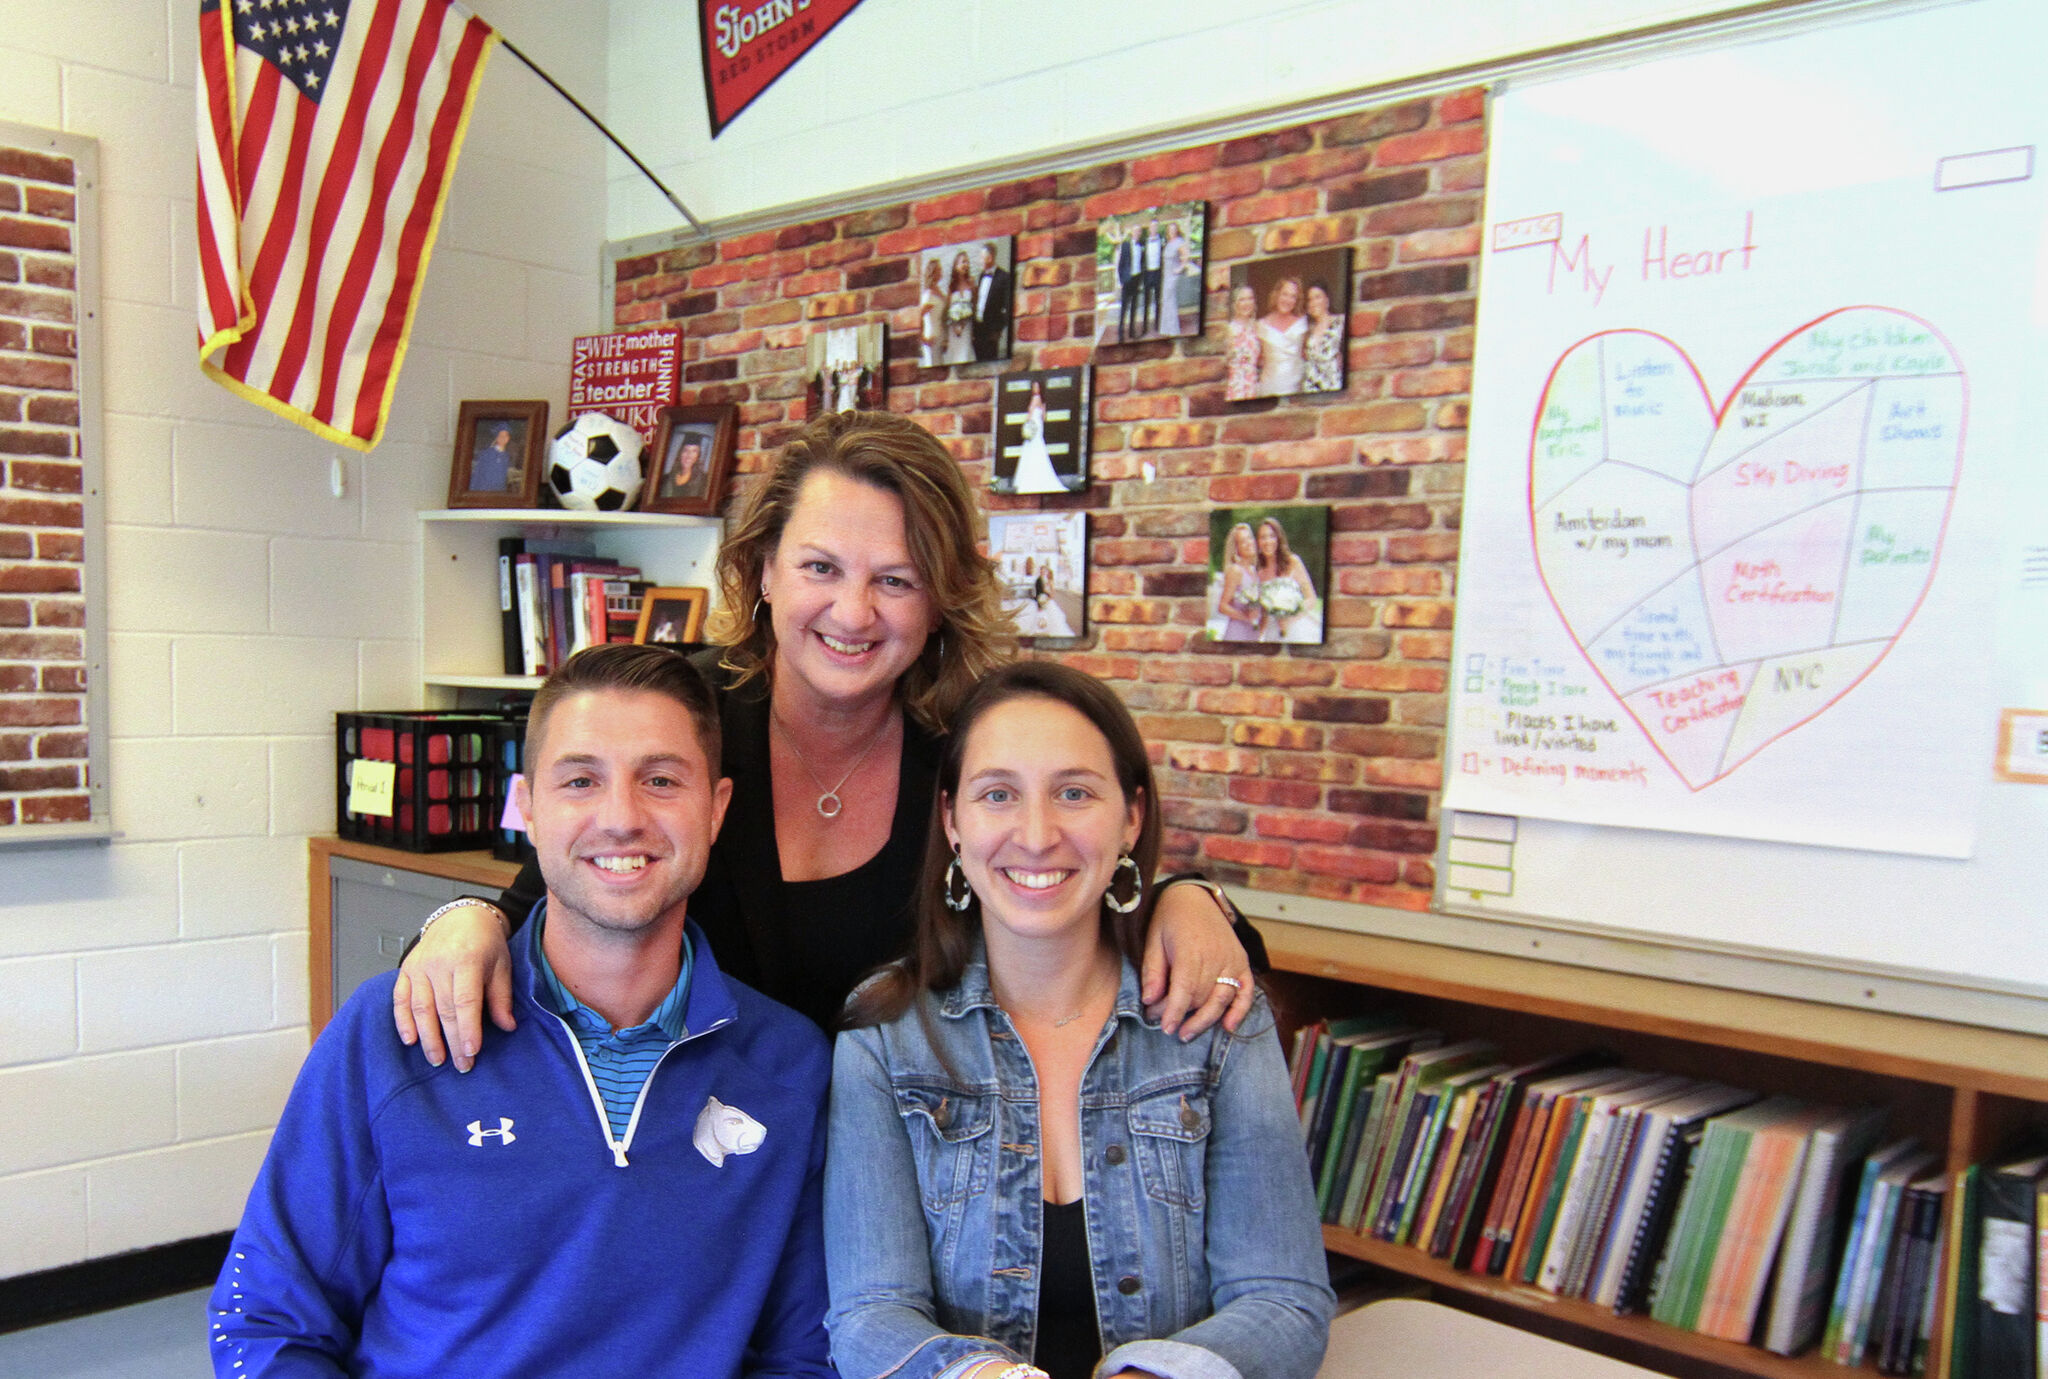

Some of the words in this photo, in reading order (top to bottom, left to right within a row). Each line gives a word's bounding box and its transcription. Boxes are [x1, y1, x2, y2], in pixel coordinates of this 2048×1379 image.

[719, 56, 750, 84] RED
[757, 18, 814, 63] STORM
[1547, 233, 1614, 308] My
[1641, 209, 1759, 281] Heart
[586, 334, 626, 359] WIFE
[625, 330, 677, 351] mother
[571, 338, 587, 404] BRAVE
[587, 358, 658, 378] STRENGTH
[655, 349, 675, 402] FUNNY
[586, 378, 655, 402] teacher
[1733, 461, 1777, 487] Sky
[1784, 459, 1850, 489] Diving
[1554, 506, 1647, 532] Amsterdam
[1602, 536, 1629, 558] my
[1633, 535, 1673, 549] mom
[1646, 669, 1740, 710] Teaching
[1774, 662, 1825, 693] NYC
[1505, 710, 1558, 733] Places
[1562, 715, 1574, 732] I
[1577, 713, 1619, 734] have
[1501, 755, 1568, 786] Defining
[1574, 759, 1650, 788] moments
